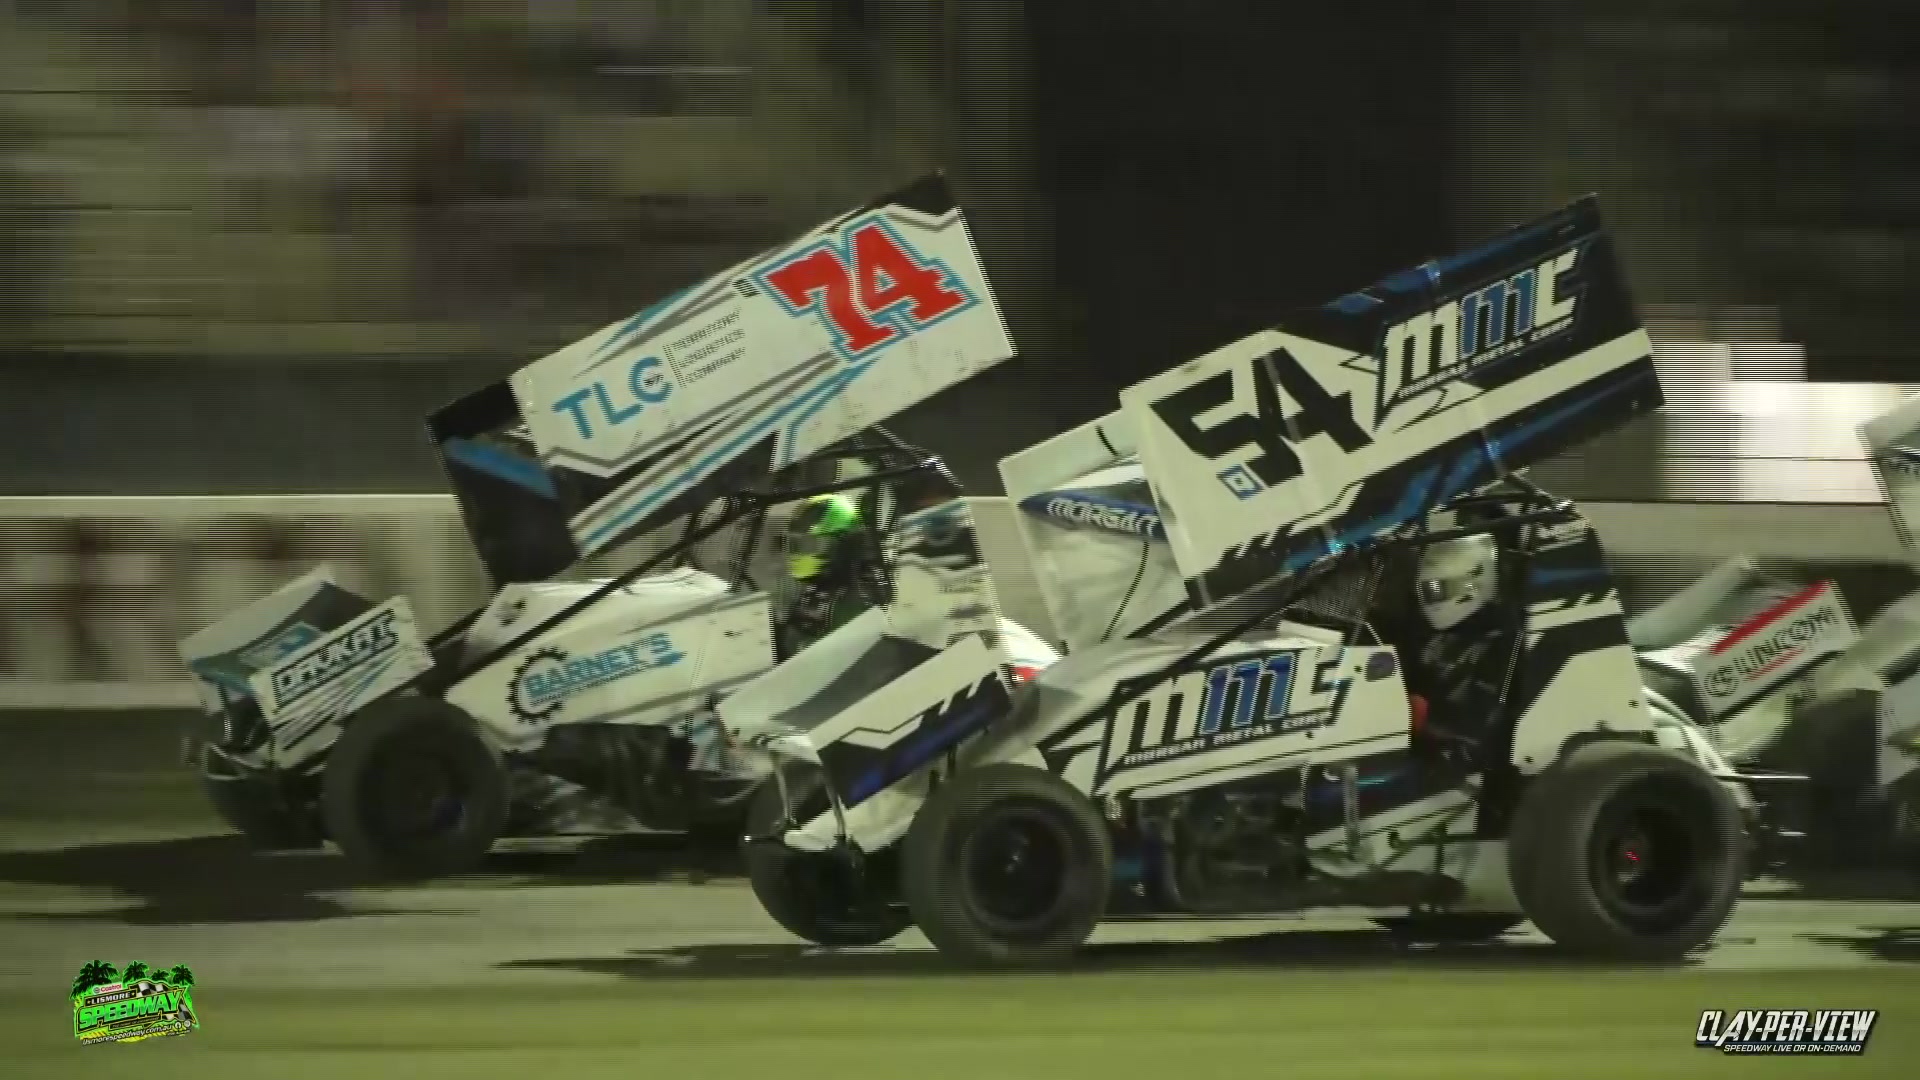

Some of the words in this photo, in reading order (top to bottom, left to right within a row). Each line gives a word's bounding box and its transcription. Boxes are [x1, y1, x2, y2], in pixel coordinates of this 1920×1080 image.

[757, 217, 977, 359] 74
[671, 309, 742, 352] TERRITORY
[678, 328, 746, 369] LOGISTICS
[685, 347, 747, 384] COMPANY
[1397, 362, 1467, 399] MORGAN
[1471, 340, 1525, 367] METAL
[551, 355, 673, 441] TLC
[1148, 346, 1375, 488] 54
[1046, 496, 1160, 536] MORGAN
[523, 632, 672, 698] BARNEY'S
[1734, 605, 1838, 675] LINCOM
[1123, 738, 1205, 765] MORGAN
[1213, 723, 1274, 746] METAL
